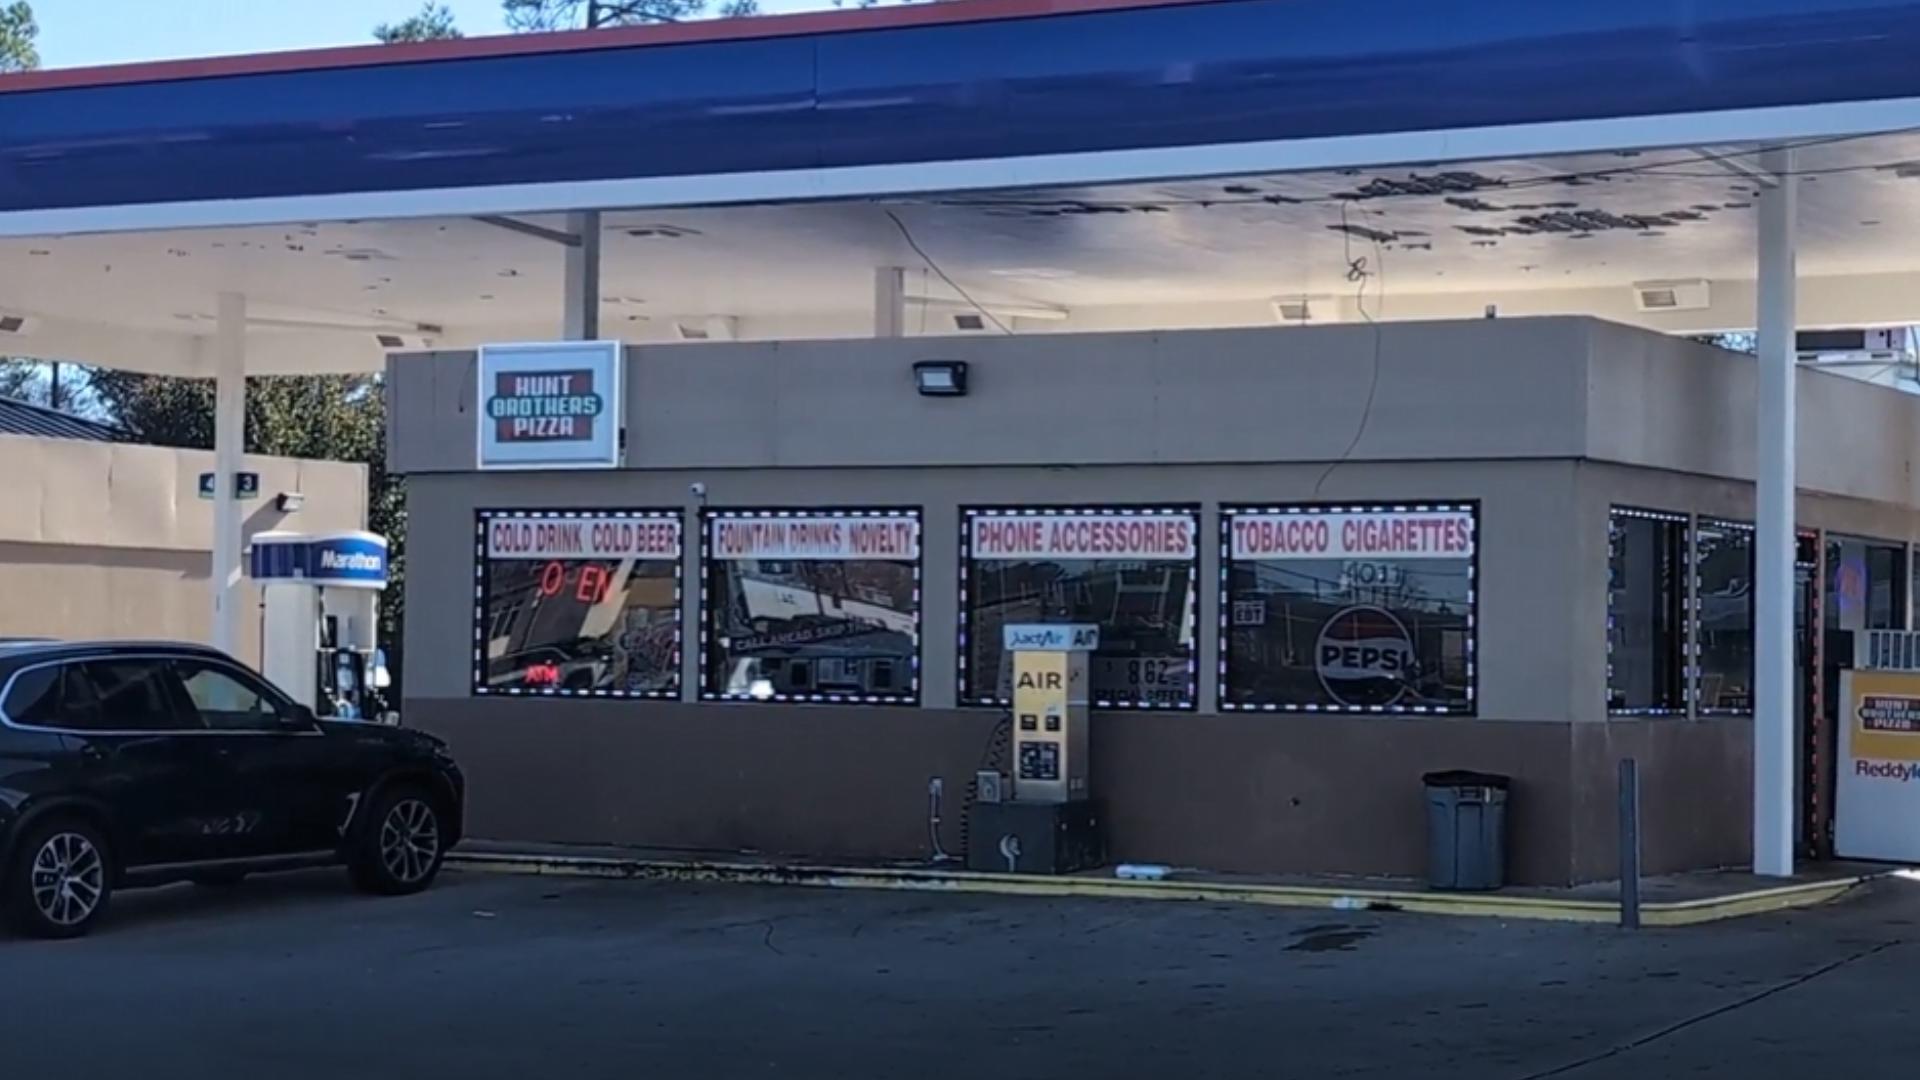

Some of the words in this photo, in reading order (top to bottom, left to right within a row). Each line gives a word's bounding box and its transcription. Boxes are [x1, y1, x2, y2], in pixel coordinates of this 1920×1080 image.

[515, 375, 573, 396] HUNT
[493, 396, 597, 417] BROTHERS
[514, 415, 574, 437] PIZZA
[243, 474, 252, 490] 3
[493, 522, 532, 553] COLD
[537, 522, 583, 553] DRINK
[592, 522, 632, 553] COLD
[637, 522, 676, 553] BEER
[718, 522, 786, 553] FOUNTAIN
[790, 522, 843, 553] DRINKS
[851, 522, 912, 553] NOVELTY
[976, 521, 1044, 552] PHONE
[1051, 520, 1189, 553] ACCESSORIES
[1234, 519, 1329, 554] TOBACCO
[1342, 518, 1470, 554] CIGARETTES
[321, 549, 382, 571] Marathon
[542, 560, 613, 604] OEN
[1322, 645, 1409, 672] PEPSI
[525, 664, 561, 684] ATM
[1017, 671, 1062, 690] AIR
